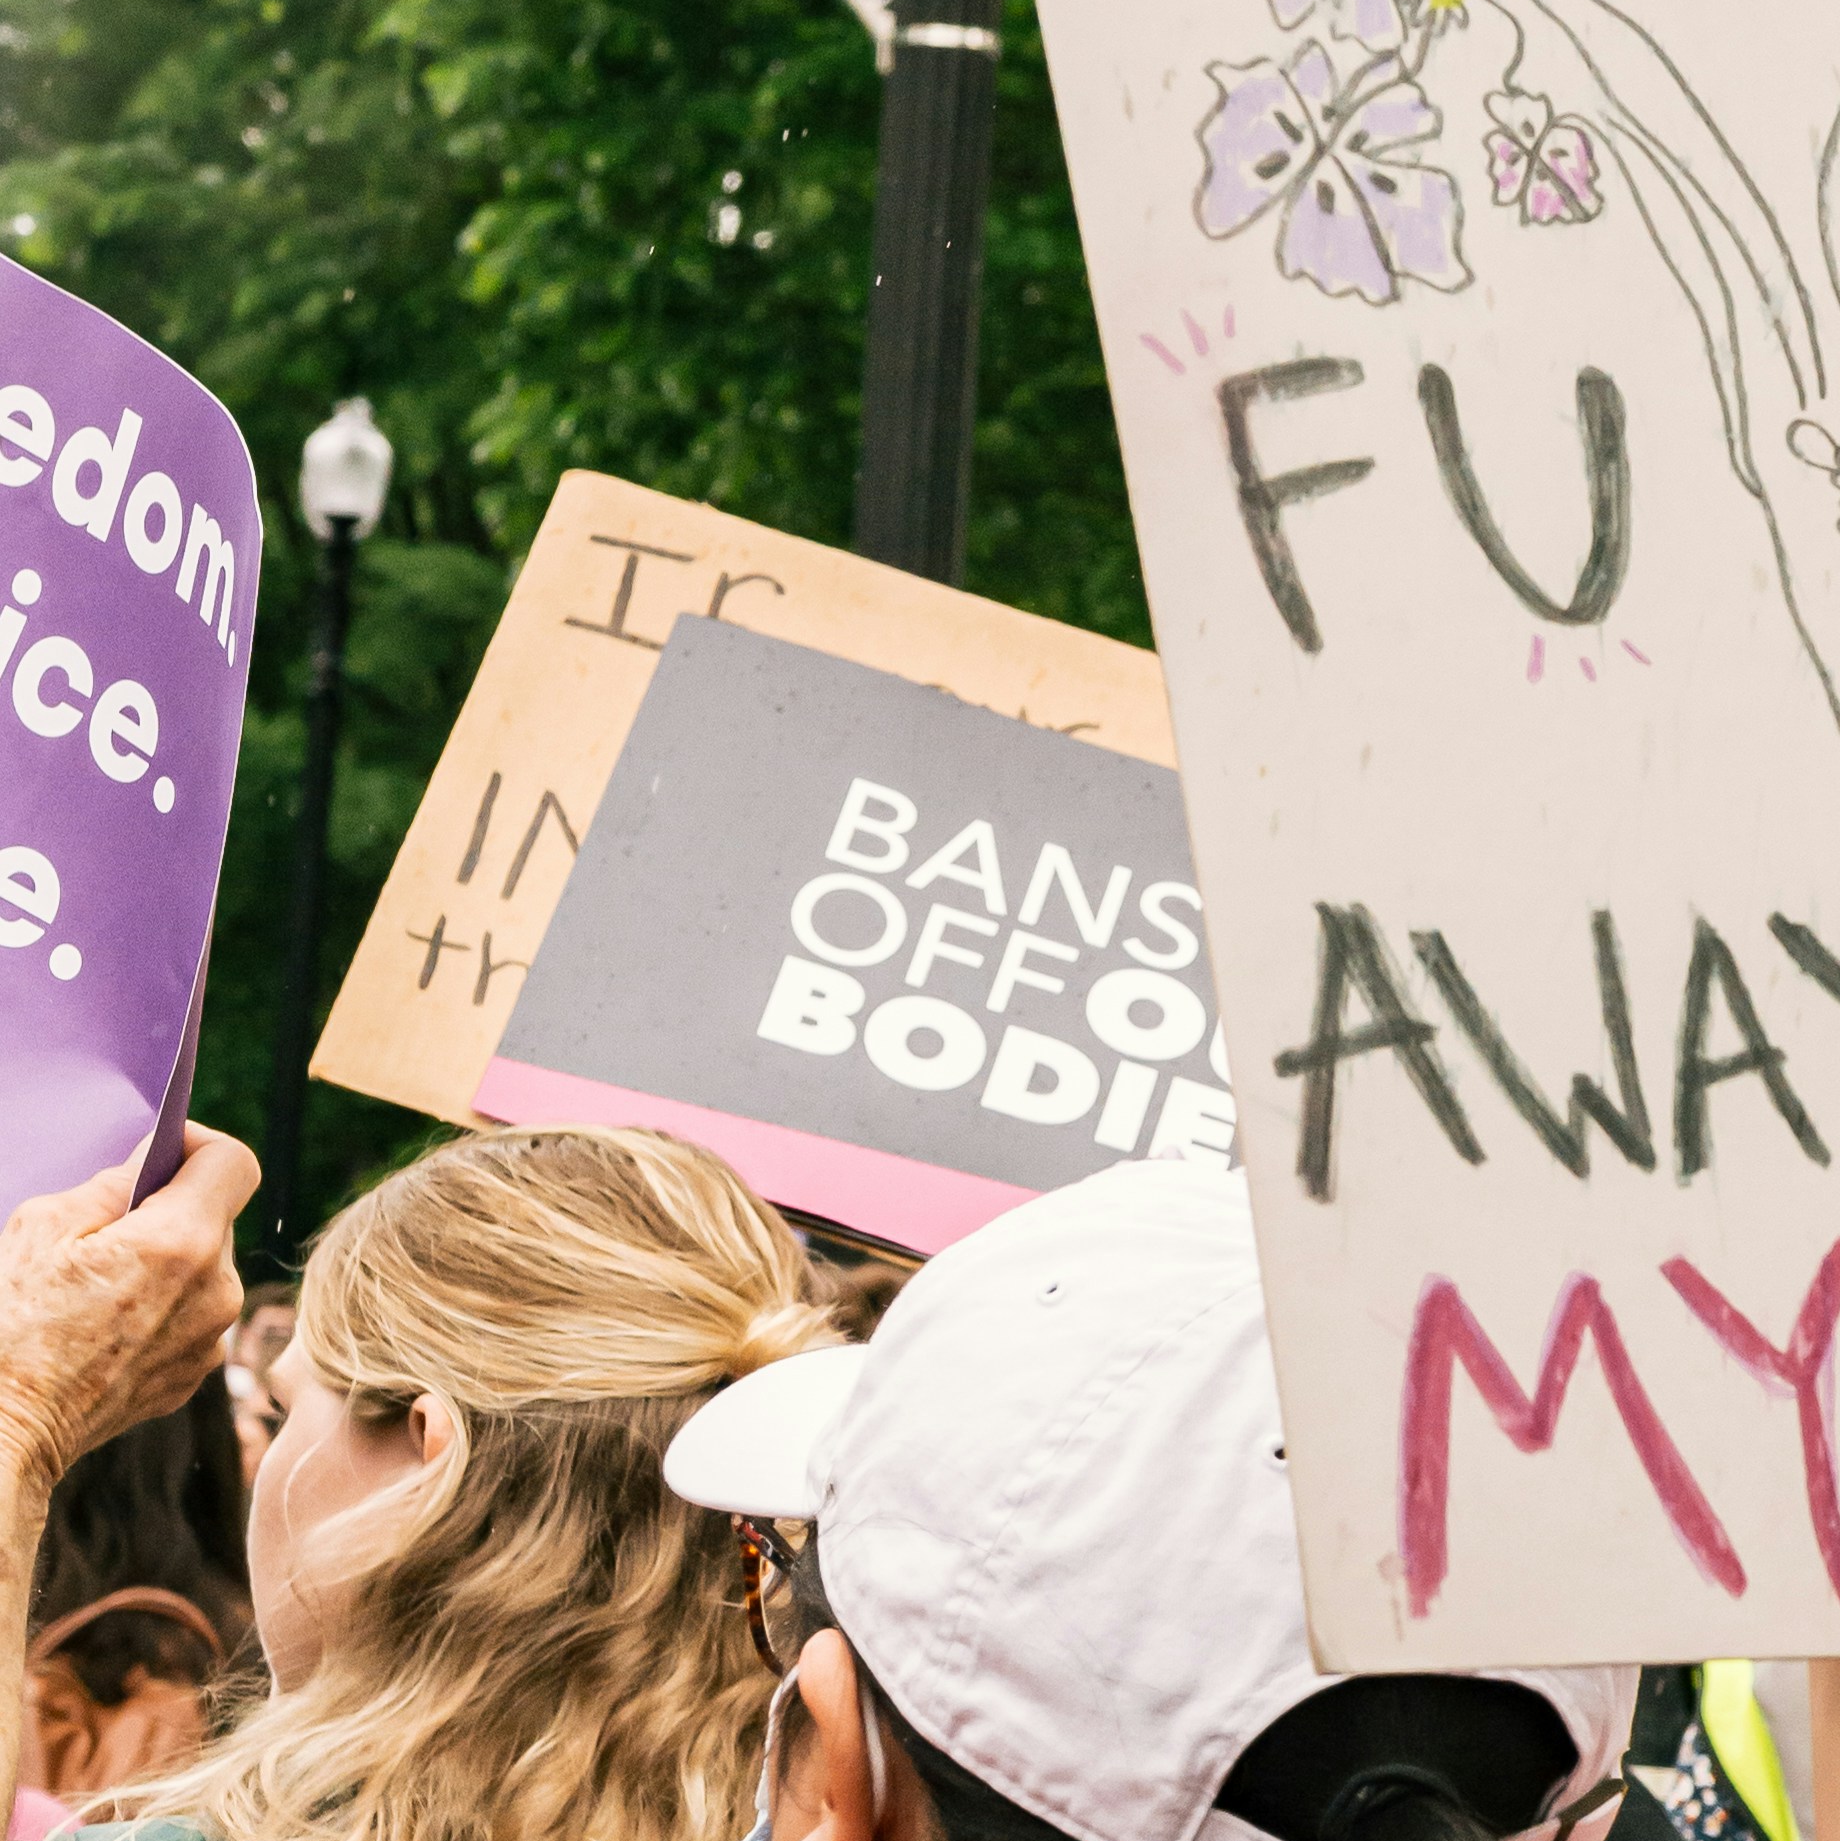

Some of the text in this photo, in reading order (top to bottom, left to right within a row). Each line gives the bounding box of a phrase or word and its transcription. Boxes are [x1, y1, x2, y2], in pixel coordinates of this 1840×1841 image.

[825, 777, 1204, 971] BANS
[790, 872, 1232, 1086] OFF O
